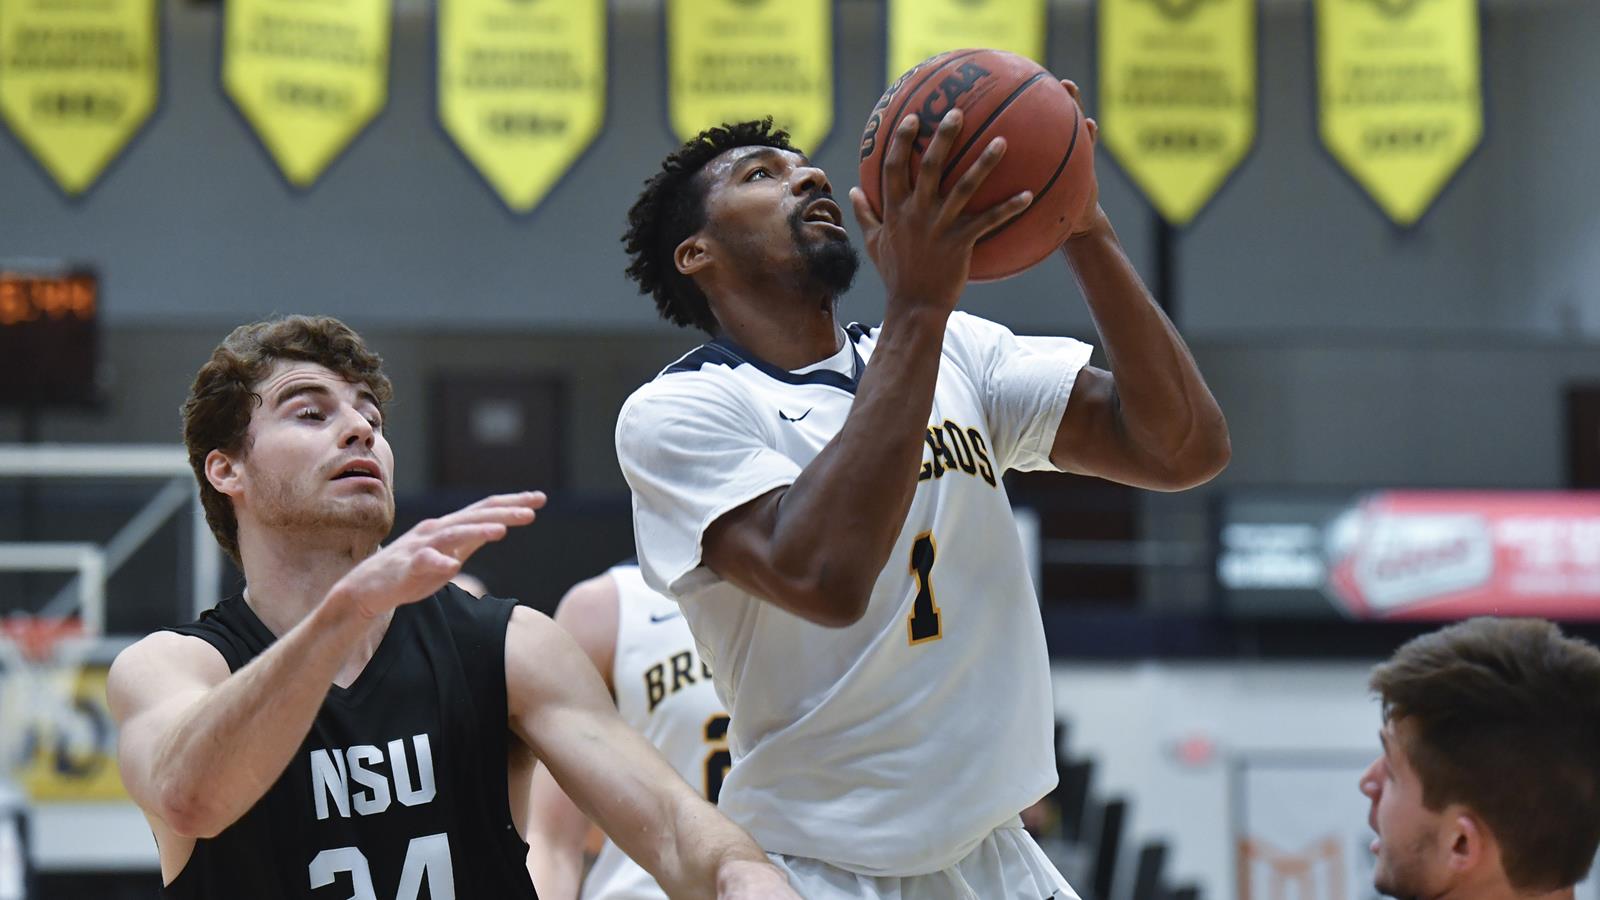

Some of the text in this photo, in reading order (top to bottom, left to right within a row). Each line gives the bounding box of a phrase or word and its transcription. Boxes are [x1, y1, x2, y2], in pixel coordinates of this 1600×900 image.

[918, 419, 997, 489] HOS
[909, 529, 942, 646] 1
[310, 733, 437, 820] NSU
